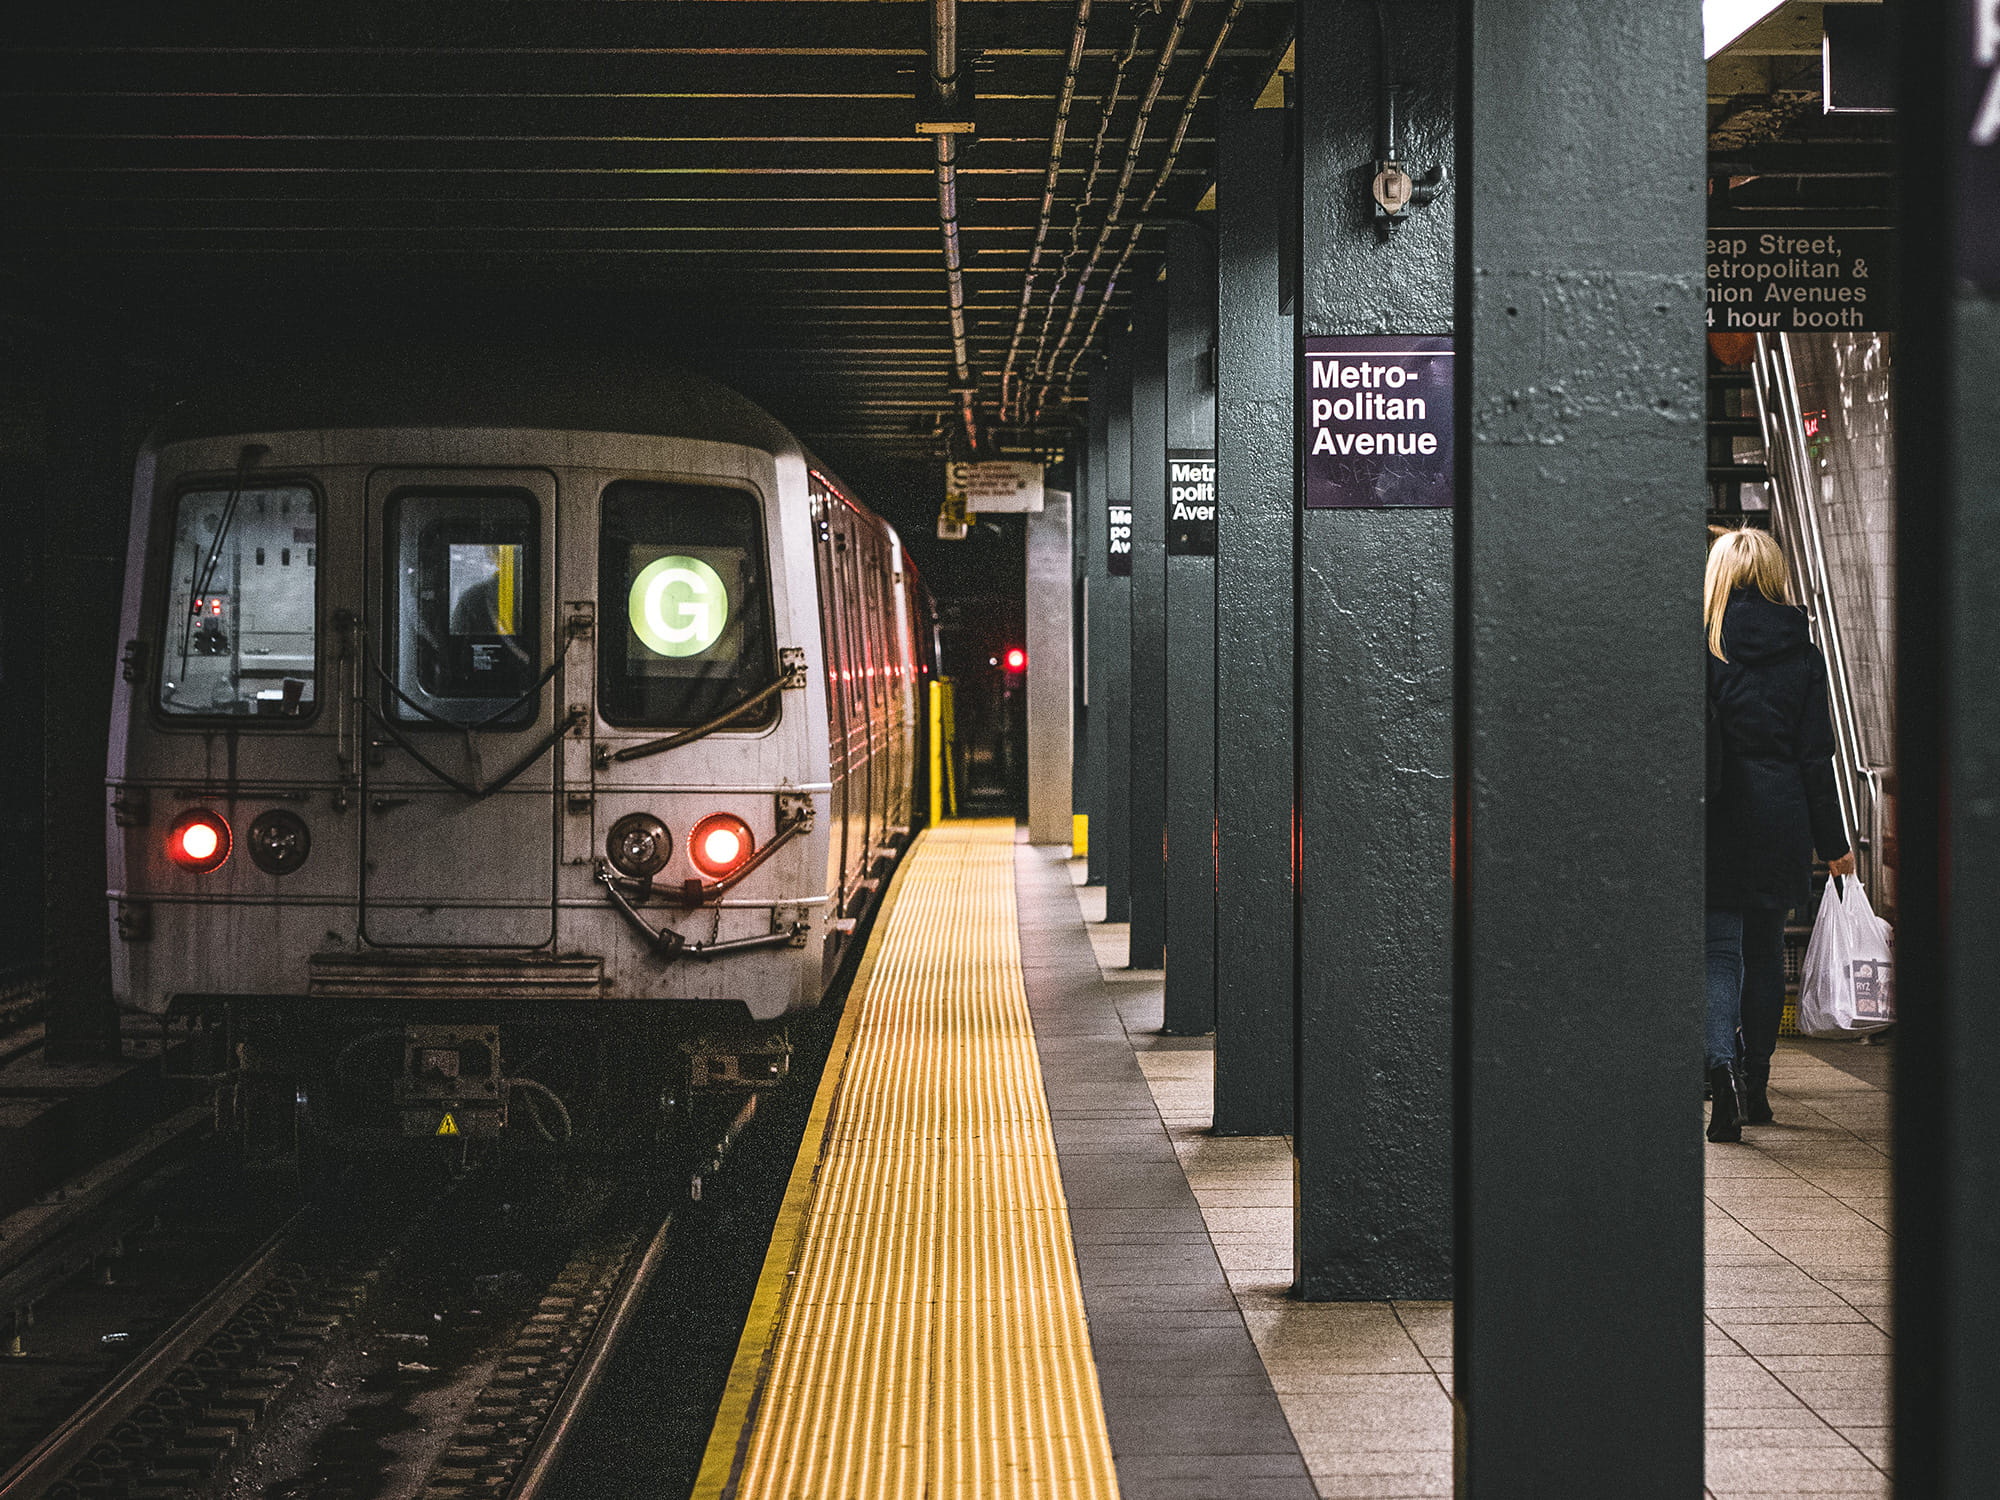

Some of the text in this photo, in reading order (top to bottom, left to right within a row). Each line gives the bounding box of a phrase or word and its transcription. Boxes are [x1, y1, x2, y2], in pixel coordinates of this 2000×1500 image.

[1760, 234, 1841, 257] Street,
[1852, 258, 1868, 278] &
[1765, 283, 1866, 302] Avenues
[1728, 307, 1781, 327] hour
[1793, 307, 1863, 327] booth
[1312, 360, 1418, 389] Metro-
[1312, 391, 1426, 428] politan
[1312, 427, 1438, 455] Avenue
[644, 568, 709, 643] G
